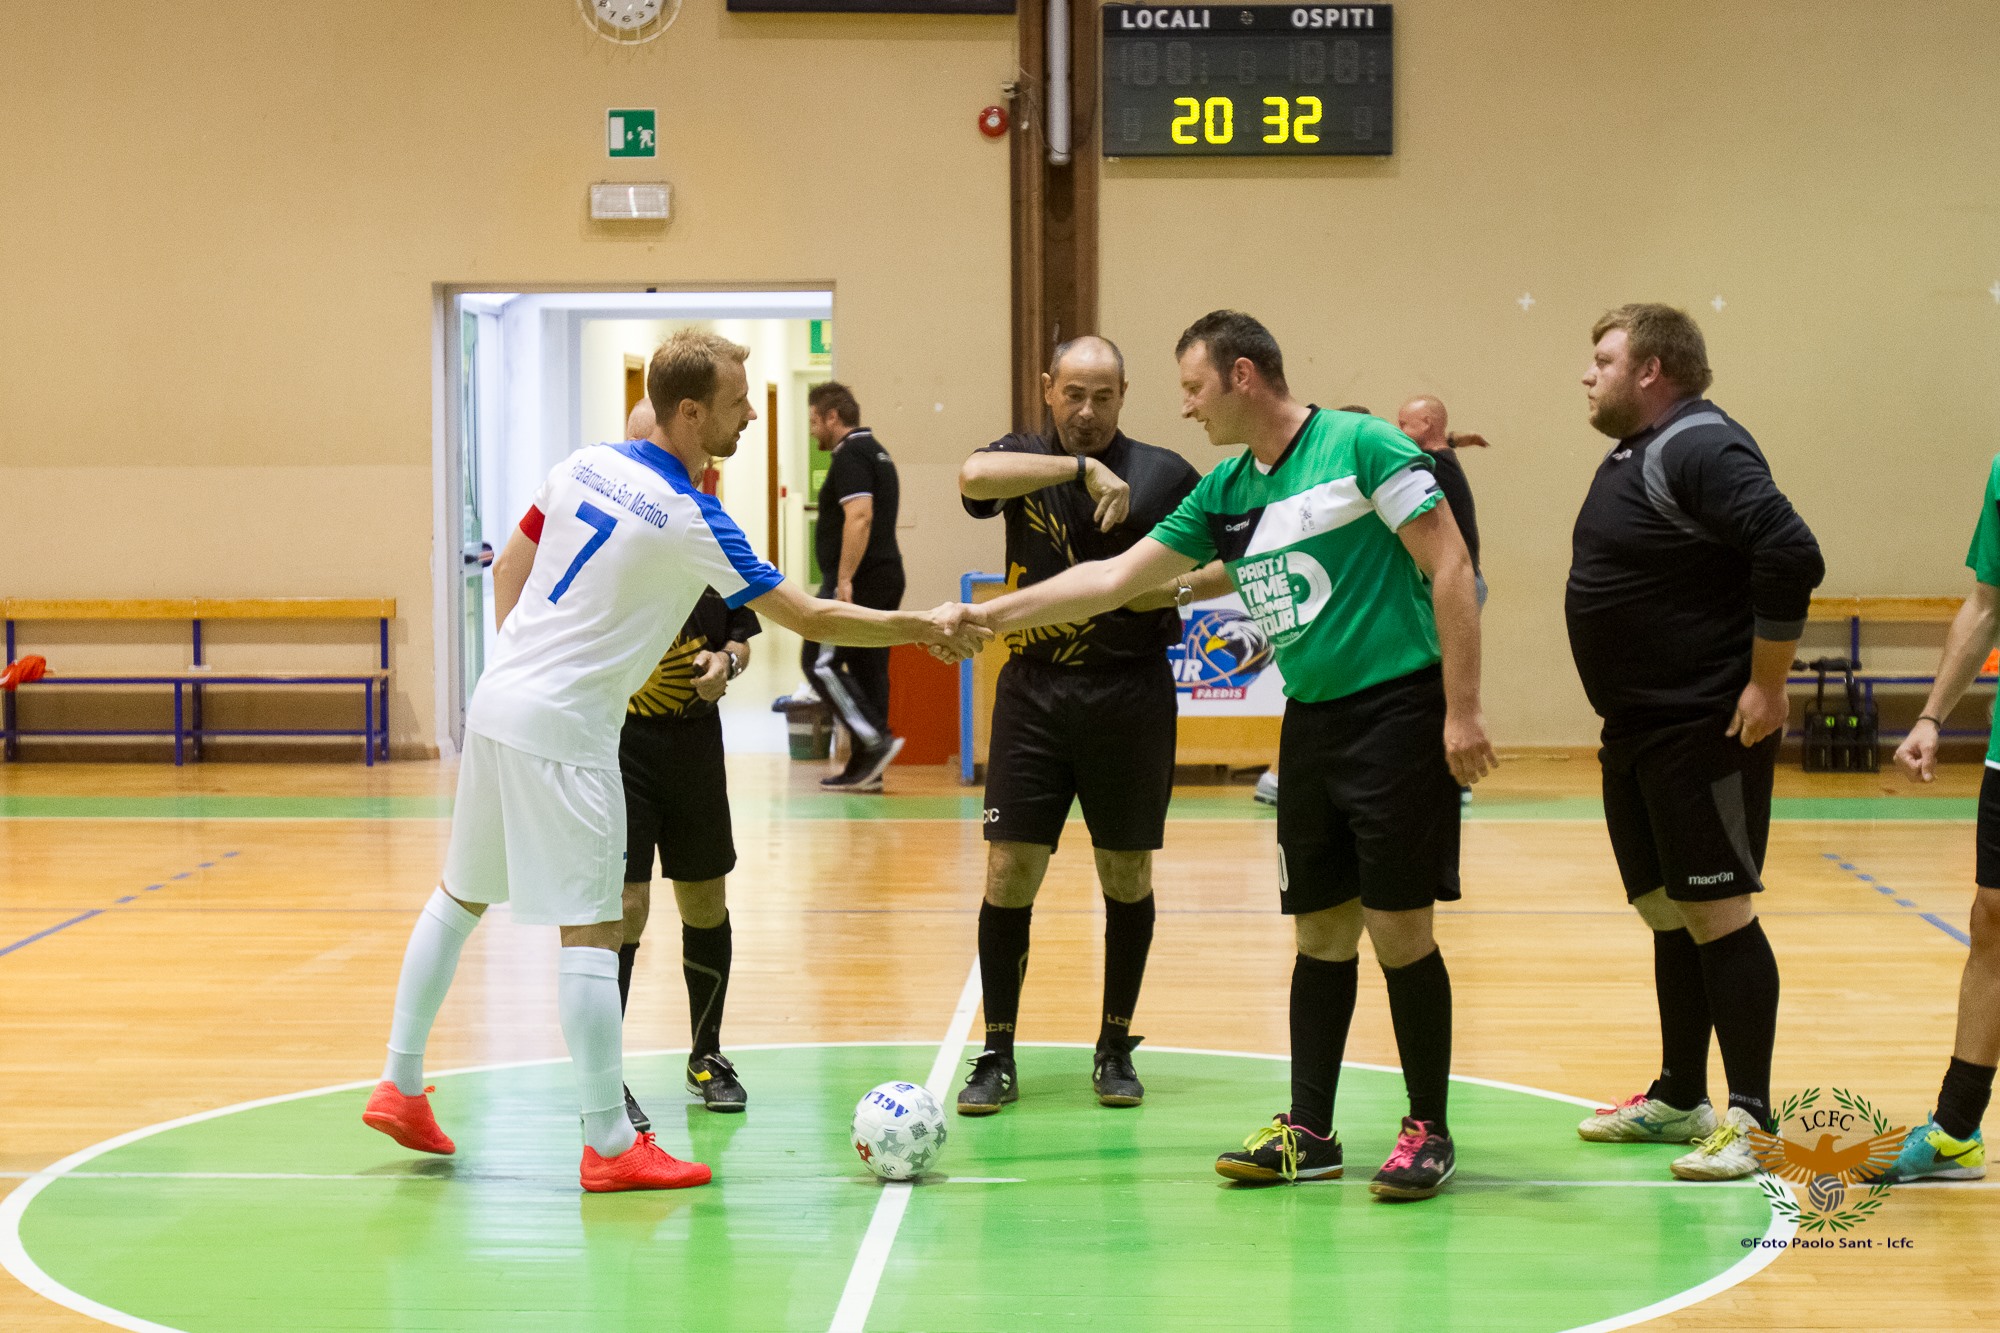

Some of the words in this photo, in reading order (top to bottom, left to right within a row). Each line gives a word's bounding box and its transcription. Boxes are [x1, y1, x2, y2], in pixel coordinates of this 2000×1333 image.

[1121, 9, 1210, 29] LOCALI
[1291, 8, 1374, 28] OSPITI
[1171, 97, 1234, 145] 20
[1262, 96, 1323, 144] 32
[611, 483, 632, 508] San
[627, 491, 669, 529] Martino
[547, 500, 618, 605] 7
[1236, 554, 1284, 584] PARTY
[1240, 572, 1291, 607] TIME
[1250, 595, 1293, 620] SUMMER
[1254, 607, 1297, 637] TOUR
[1196, 687, 1243, 699] FAEDIS
[1688, 871, 1734, 886] macron
